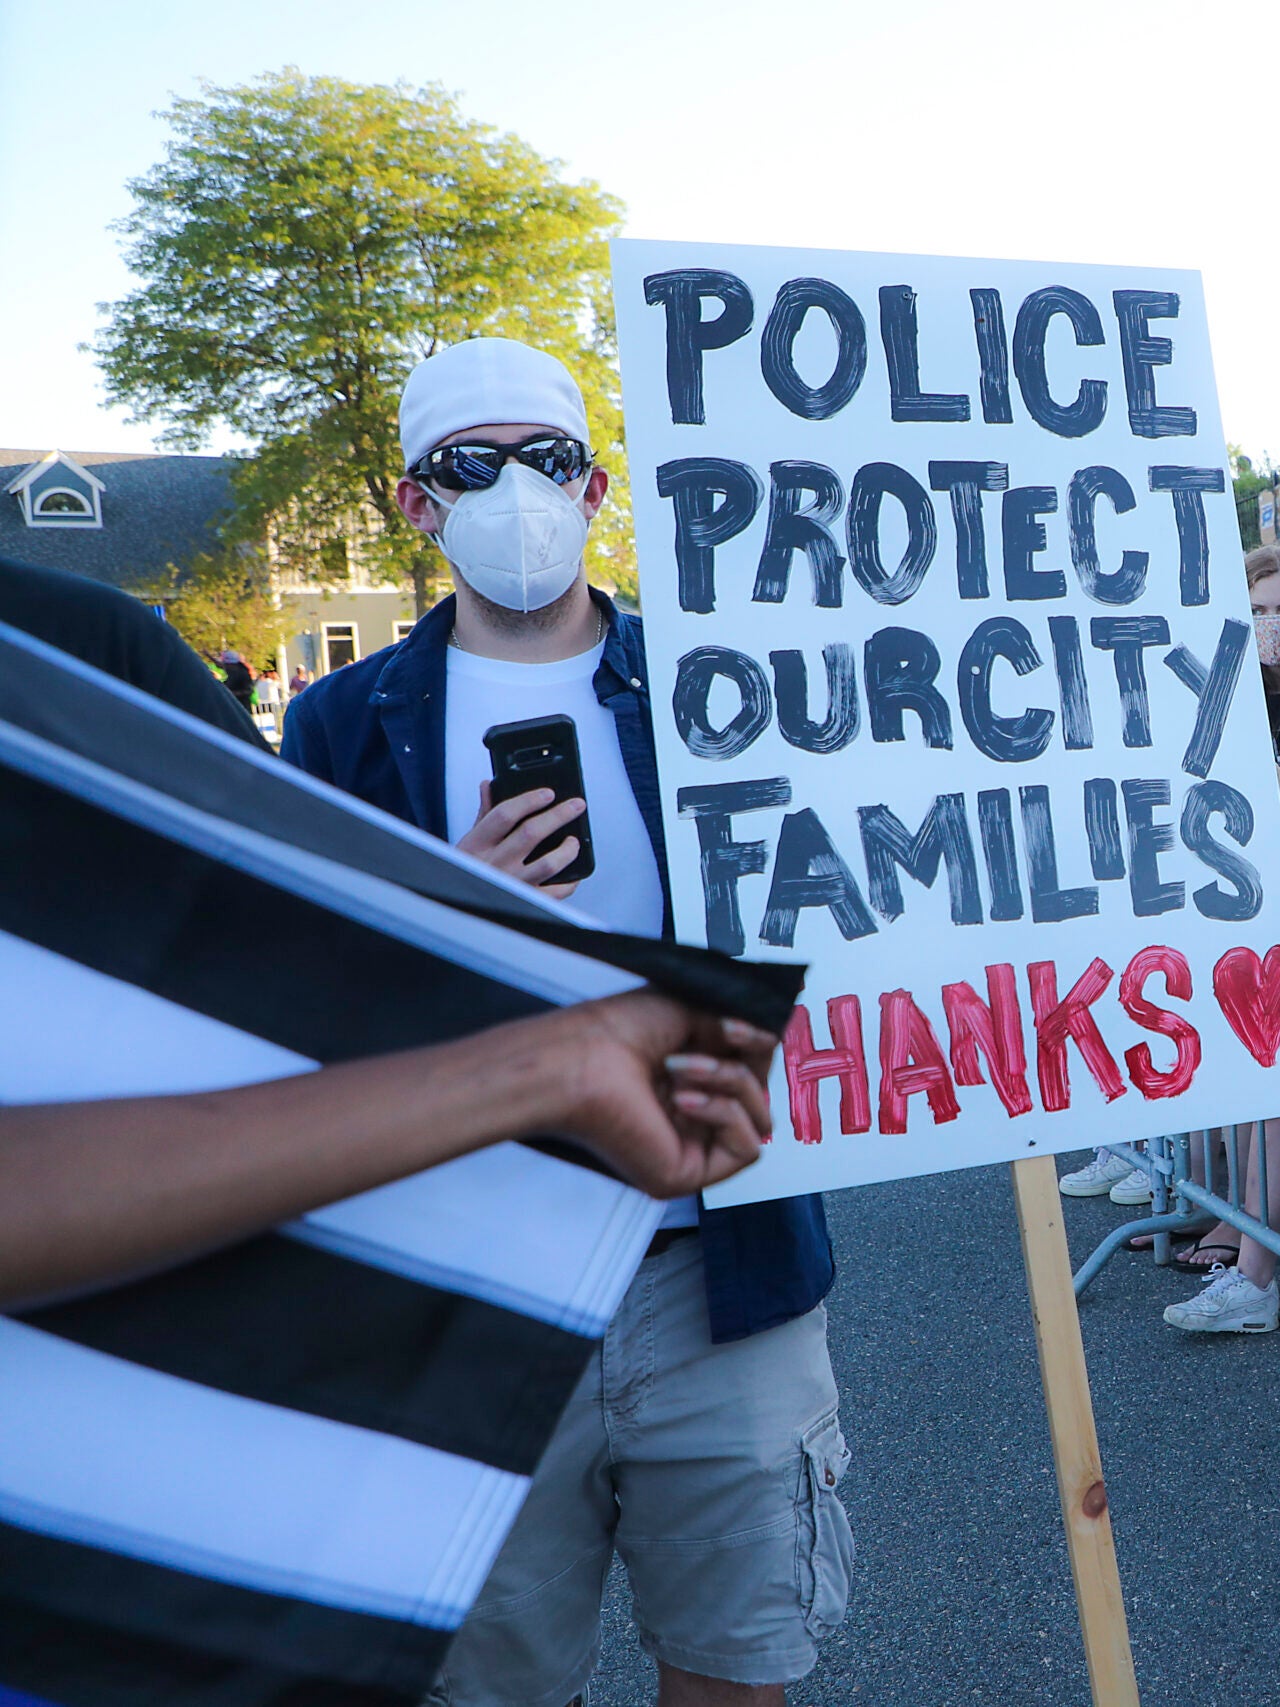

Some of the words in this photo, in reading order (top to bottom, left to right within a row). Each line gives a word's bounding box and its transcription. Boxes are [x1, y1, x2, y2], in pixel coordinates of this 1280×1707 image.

[643, 268, 1198, 438] POLICE
[656, 457, 1226, 615] PROTECT
[677, 776, 1264, 957] FAMILIES
[764, 944, 1203, 1145] HANKS
